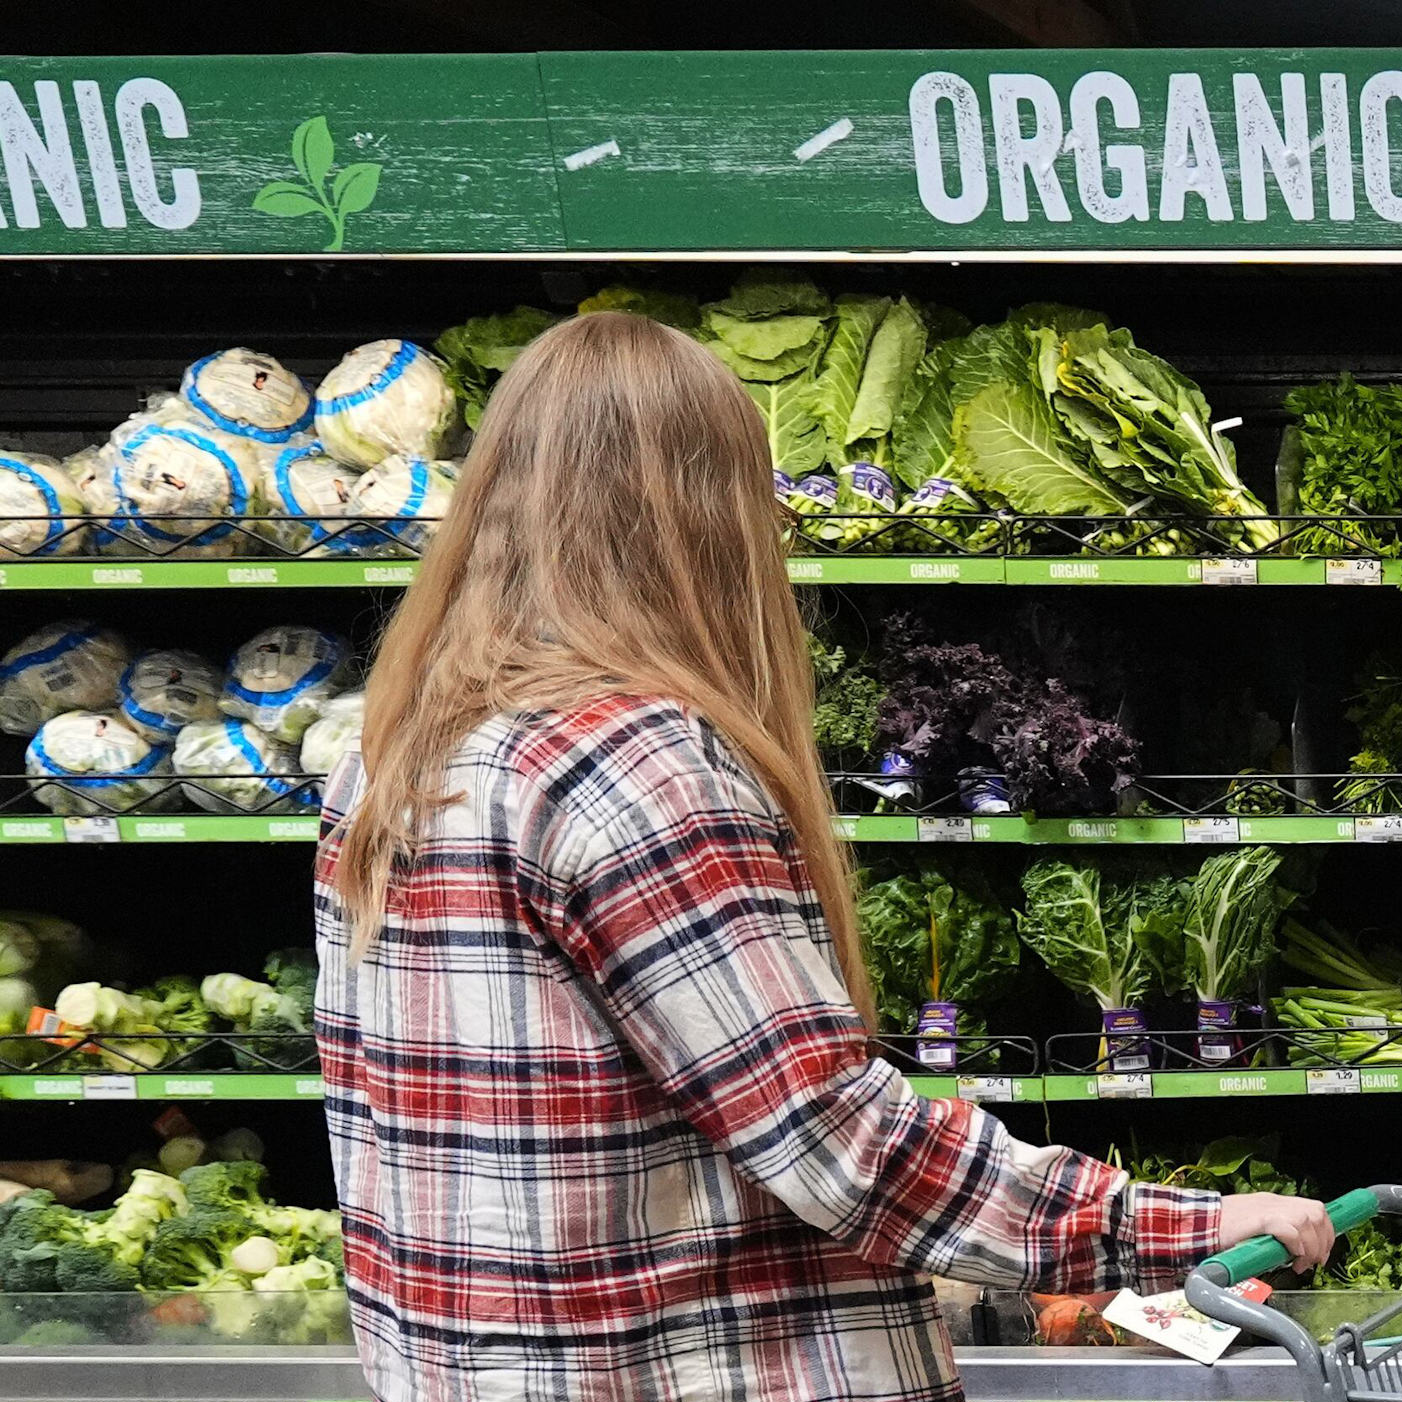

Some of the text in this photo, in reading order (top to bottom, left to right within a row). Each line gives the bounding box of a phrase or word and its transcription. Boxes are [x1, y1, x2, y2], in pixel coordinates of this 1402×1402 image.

[0, 77, 202, 229] NIC
[788, 564, 823, 578] GANIC
[910, 563, 960, 578] ORGANIC
[1049, 564, 1100, 579] ORGANIC
[1068, 823, 1117, 838] ORGANIC
[1219, 1077, 1267, 1092] ORGANIC
[1361, 1074, 1398, 1089] RGANIC
